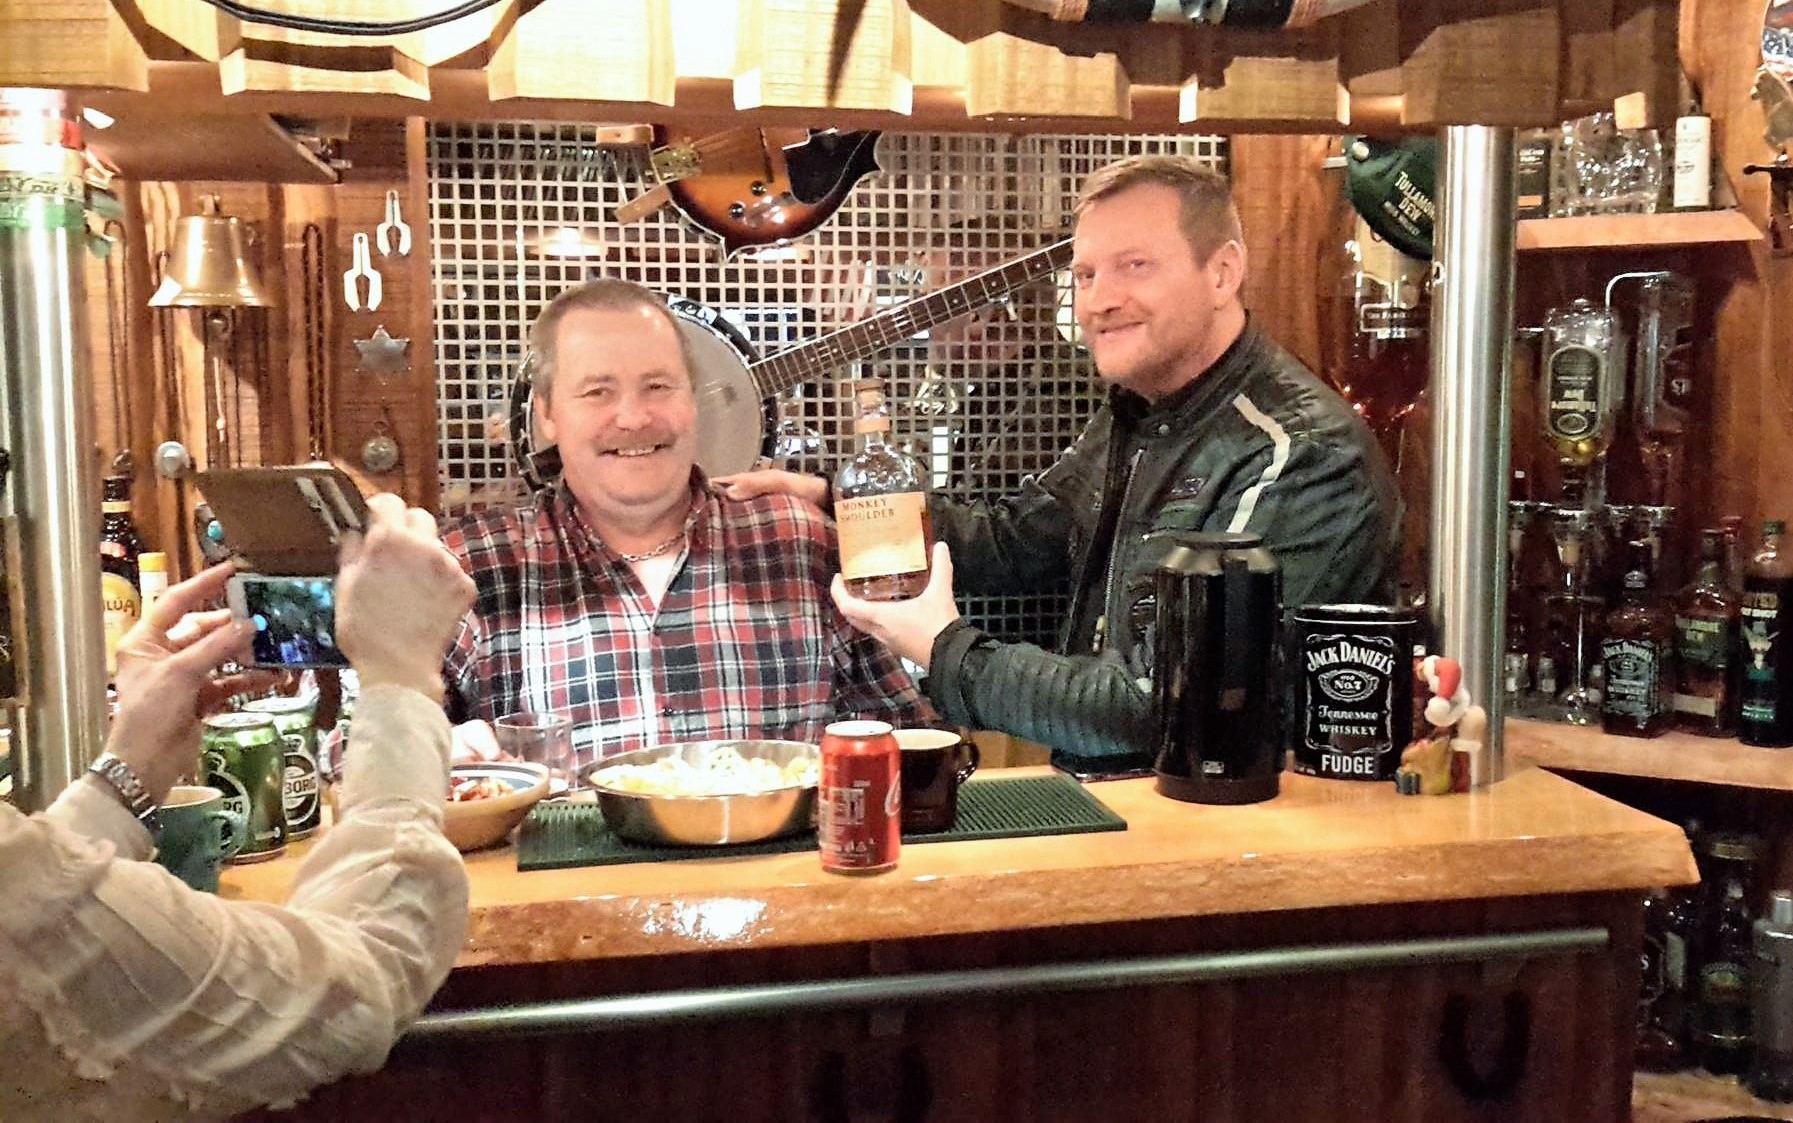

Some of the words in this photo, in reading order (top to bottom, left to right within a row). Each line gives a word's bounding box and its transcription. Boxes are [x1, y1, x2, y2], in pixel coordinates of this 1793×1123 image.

[1394, 171, 1436, 221] TULLAMOR
[842, 498, 888, 510] MONKEY
[103, 596, 136, 617] LÚA
[1307, 646, 1340, 672] JACK
[1340, 641, 1396, 675] DANIEL'S
[1318, 705, 1379, 721] Tennessee
[1318, 723, 1378, 736] WHISKEY
[1321, 754, 1376, 775] FUDGE
[285, 776, 316, 794] BORG
